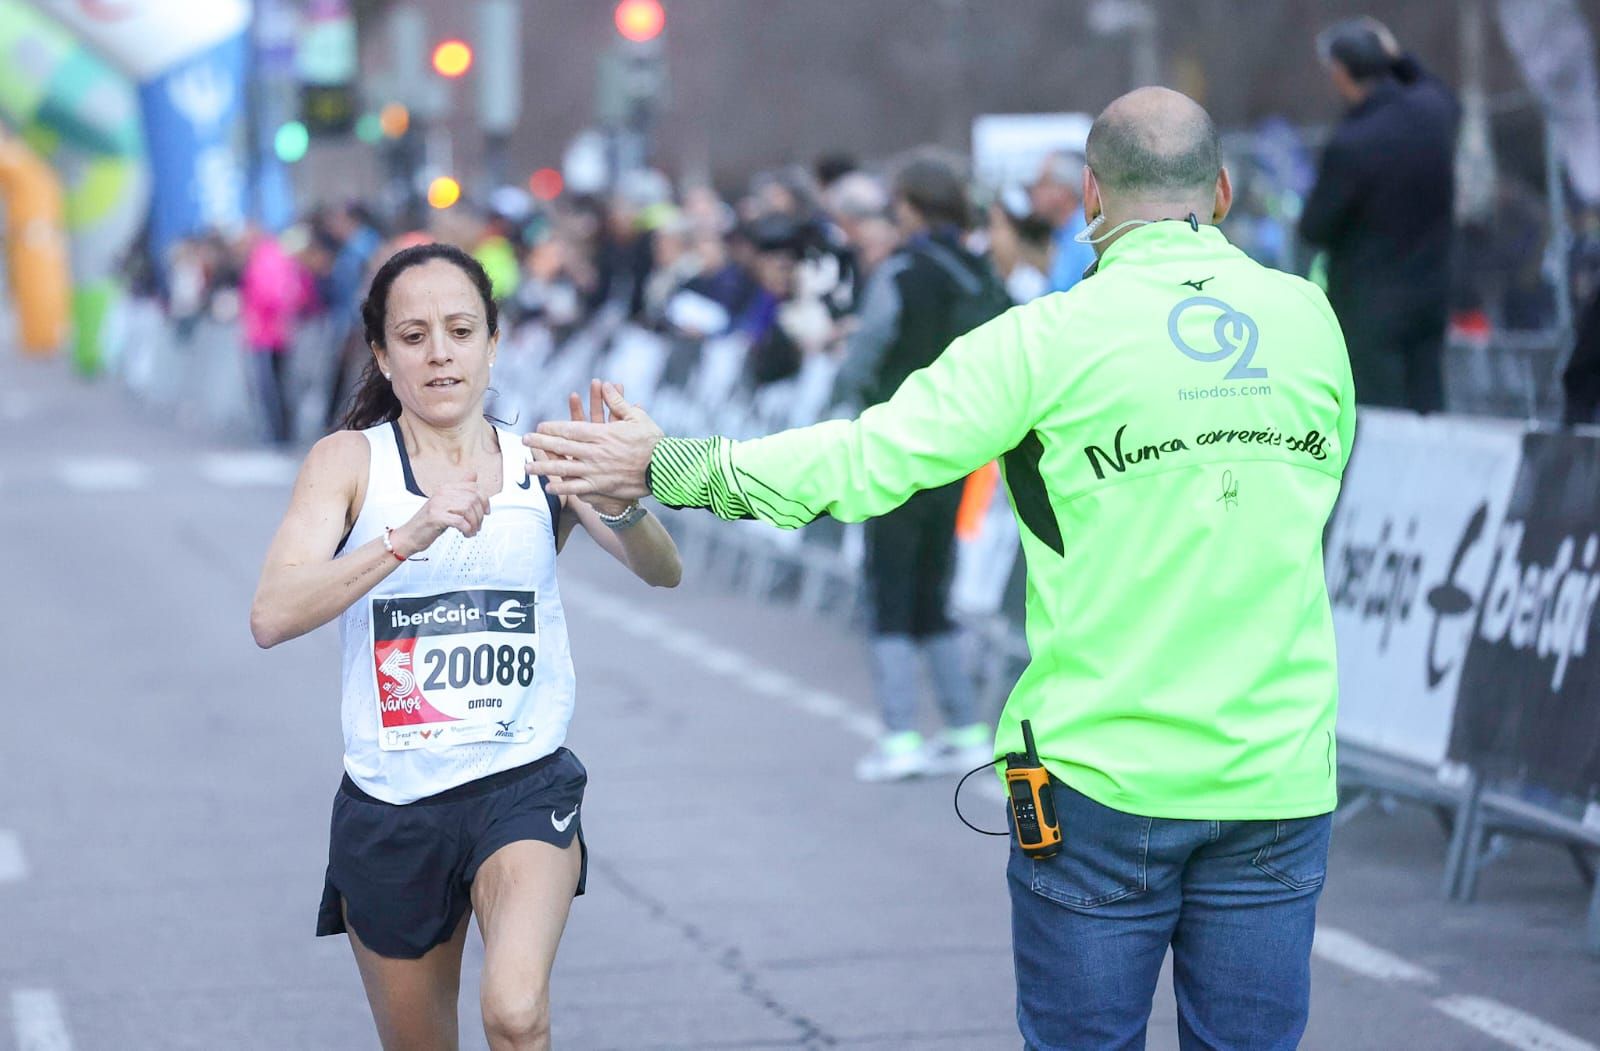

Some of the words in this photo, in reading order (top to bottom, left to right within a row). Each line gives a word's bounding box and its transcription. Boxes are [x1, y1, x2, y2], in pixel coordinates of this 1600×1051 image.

[1178, 384, 1272, 402] fisiodos.com
[1084, 424, 1190, 480] Nunca
[391, 603, 481, 629] iberCaja
[423, 643, 536, 691] 20088
[468, 698, 503, 710] amaro
